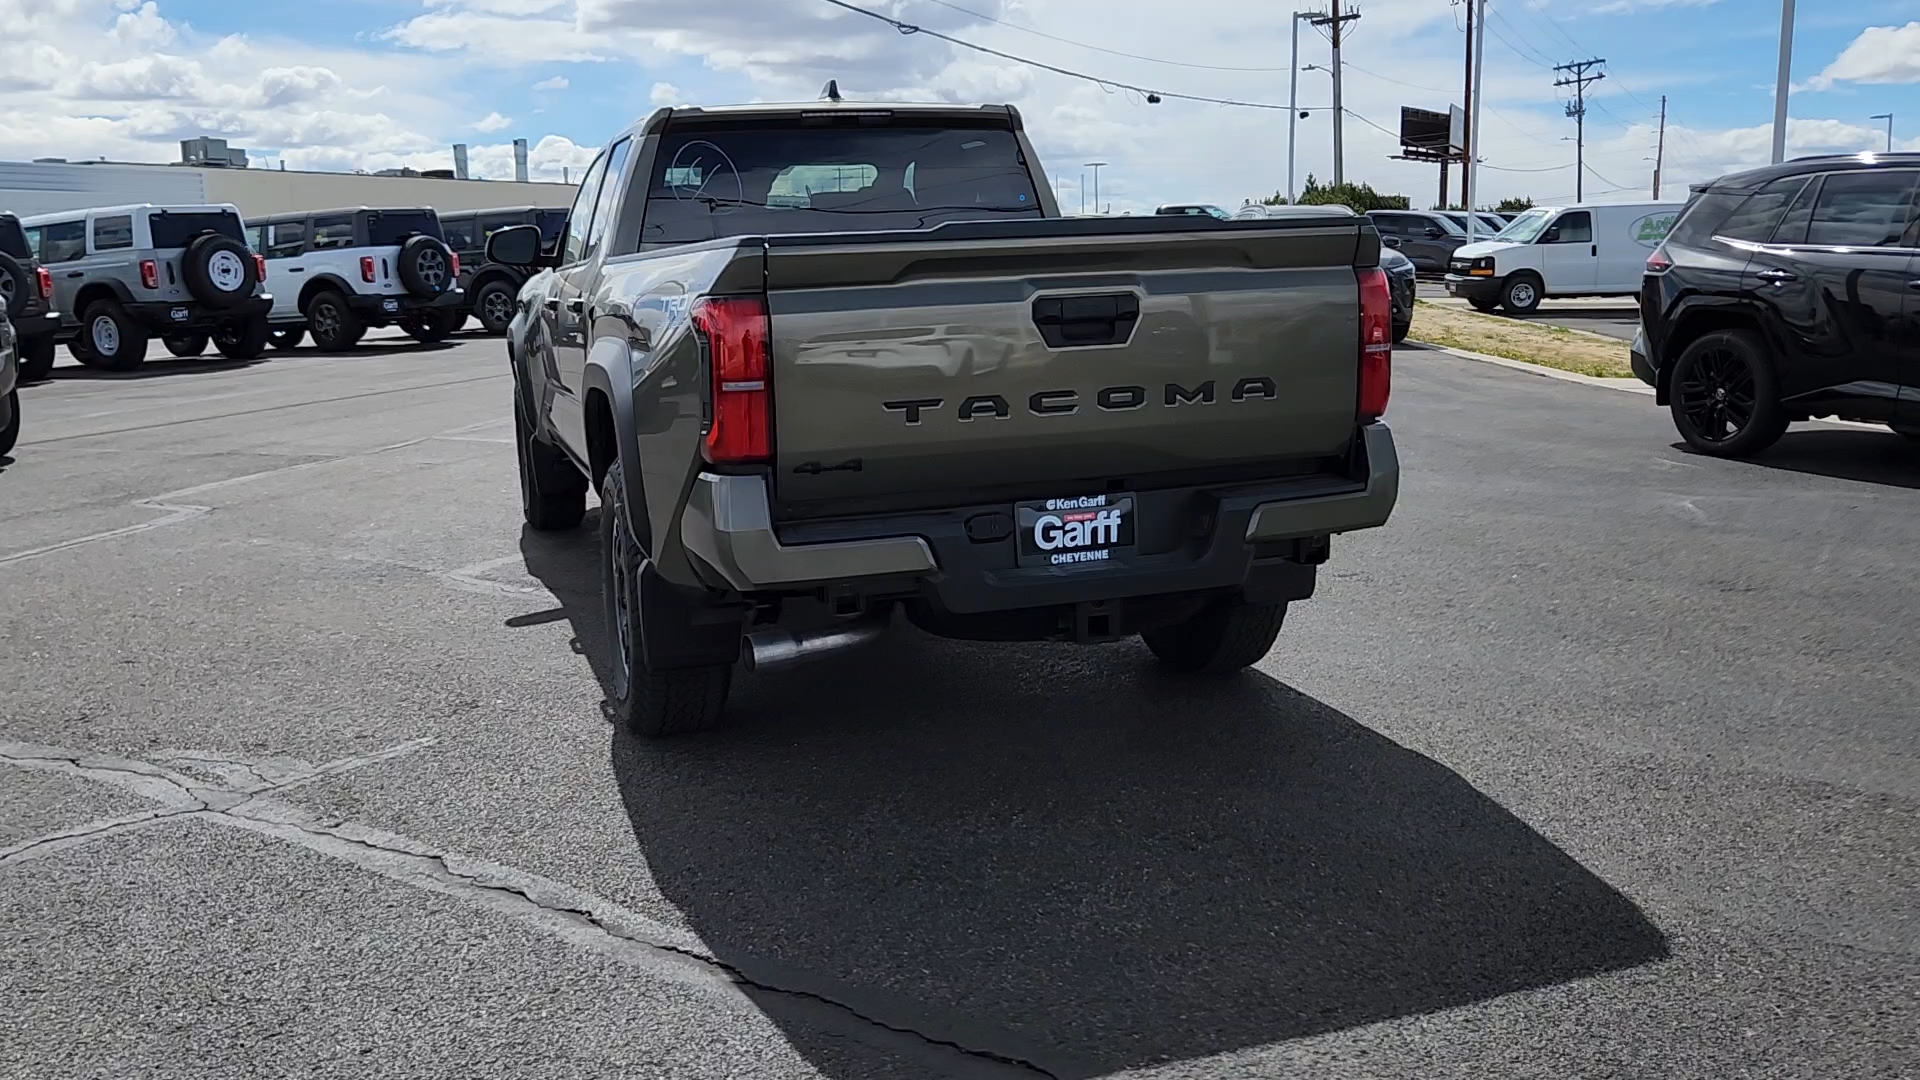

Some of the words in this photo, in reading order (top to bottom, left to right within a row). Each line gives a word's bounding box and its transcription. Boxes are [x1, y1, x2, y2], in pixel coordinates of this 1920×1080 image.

[660, 294, 689, 318] TRD
[881, 376, 1278, 427] TACOMA
[1056, 498, 1078, 510] Ken
[1078, 494, 1107, 509] Garff
[1034, 508, 1122, 551] Garff
[1050, 549, 1109, 565] CHEYENNE
